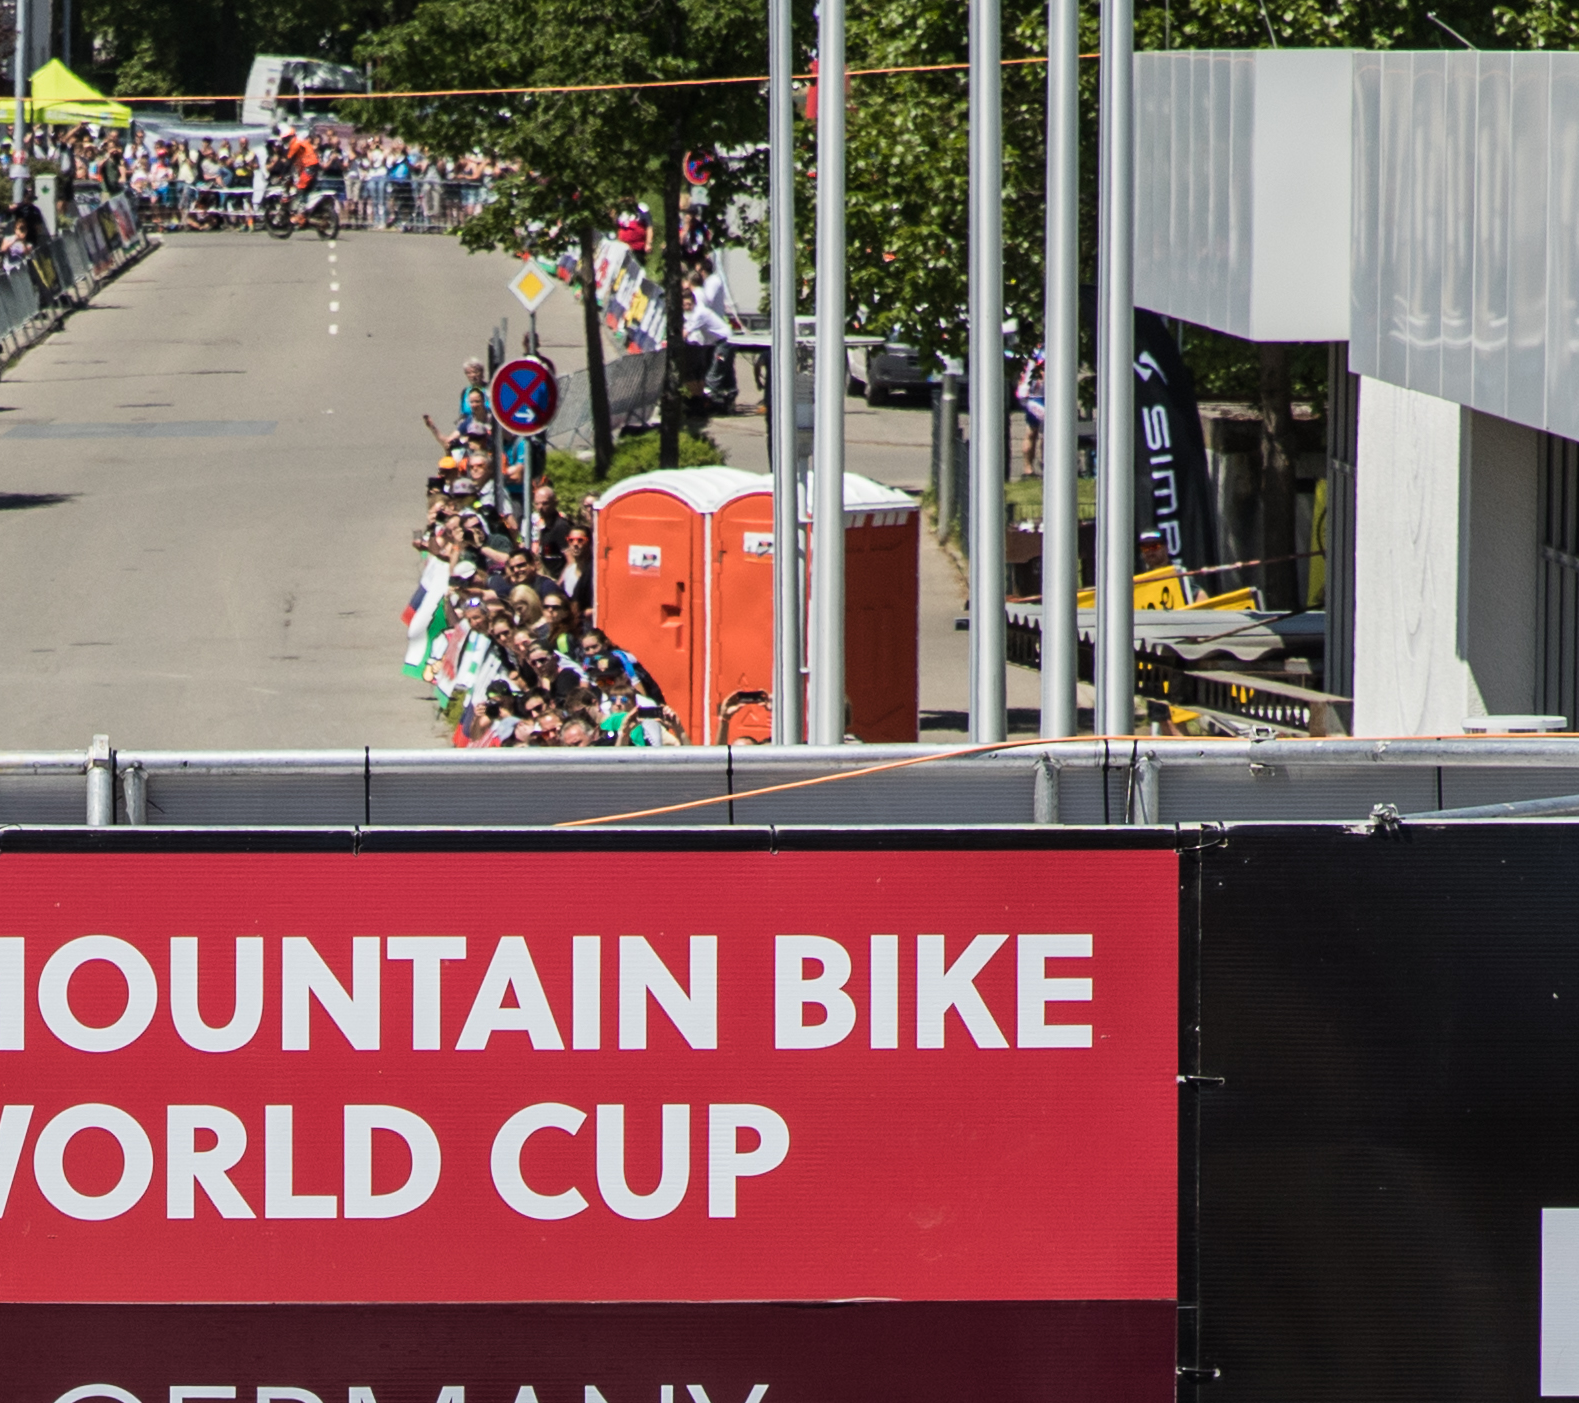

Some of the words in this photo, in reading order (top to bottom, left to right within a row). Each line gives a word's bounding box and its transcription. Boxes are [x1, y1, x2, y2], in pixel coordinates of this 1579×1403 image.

[1142, 404, 1182, 565] SIMP
[775, 932, 1096, 1050] BIKE
[488, 1102, 791, 1221] CUP
